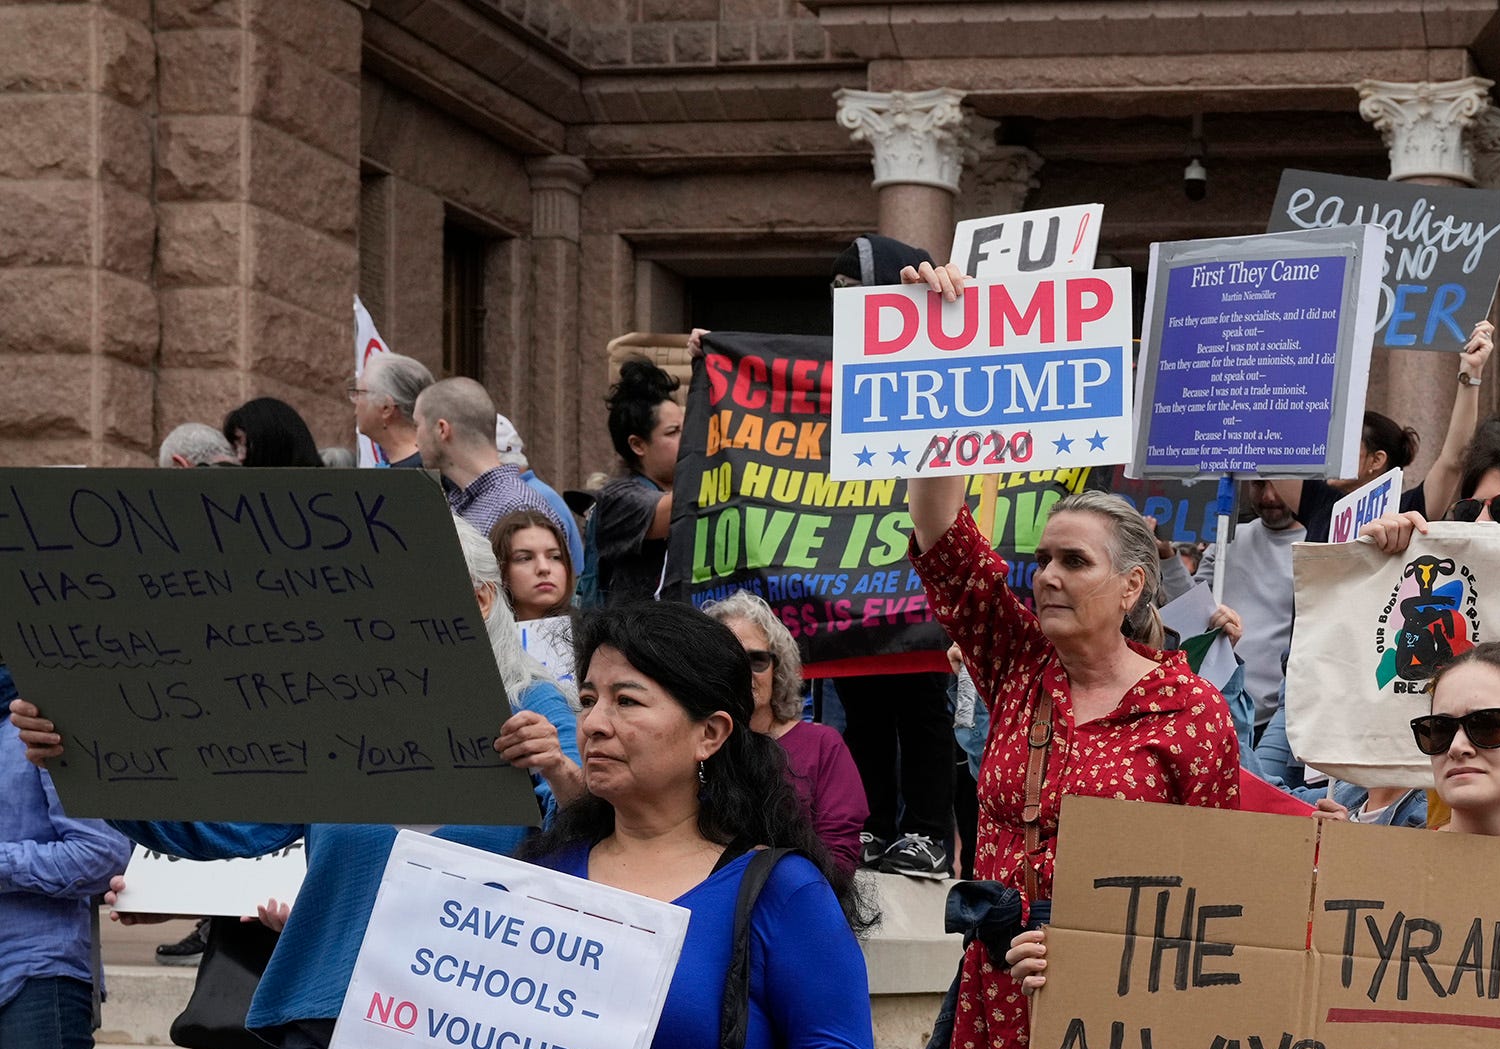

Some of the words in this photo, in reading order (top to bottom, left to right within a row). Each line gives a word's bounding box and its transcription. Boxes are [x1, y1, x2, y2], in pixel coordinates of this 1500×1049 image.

[1191, 265, 1225, 287] First
[1228, 261, 1268, 288] They
[1270, 260, 1319, 281] Came
[1396, 244, 1438, 280] NO
[864, 277, 1114, 356] DUMP
[1168, 316, 1184, 327] First
[1184, 314, 1200, 328] they
[1199, 316, 1218, 325] came
[1218, 312, 1230, 323] for
[1230, 311, 1243, 322] the
[1243, 309, 1281, 322] socialists,
[1282, 308, 1299, 320] and
[1300, 308, 1305, 319] I
[1305, 307, 1320, 319] did
[1321, 309, 1336, 319] not
[1221, 291, 1242, 302] Martin
[1242, 289, 1276, 300] Niemöller
[1196, 343, 1224, 354] Because
[1225, 341, 1229, 352] I
[1230, 343, 1245, 351] was
[1245, 341, 1259, 351] not
[1259, 342, 1265, 351] a
[1266, 338, 1301, 350] socialist.
[1221, 325, 1246, 339] speak
[854, 358, 1111, 423] TRUMP
[706, 411, 828, 460] BLACK
[698, 465, 732, 508] NO
[740, 461, 897, 508] HUMAN
[201, 490, 408, 555] MUSK
[1333, 506, 1352, 543] NO
[692, 507, 831, 584] LOVE
[839, 513, 913, 569] IS
[20, 568, 116, 606] HAS
[140, 570, 232, 599] BEEN
[256, 564, 374, 600] GIVEN
[767, 573, 848, 602] RIGHTS
[851, 571, 901, 596] ARE
[1378, 576, 1406, 624] BODIE
[1460, 565, 1480, 642] DESERVE
[18, 621, 181, 660] ILLEGAL
[206, 619, 325, 650] ACCESS
[344, 617, 396, 642] TO
[410, 616, 477, 646] THE
[1376, 627, 1385, 654] OUR
[118, 682, 211, 723] U.S.
[225, 667, 430, 712] TREASURY
[439, 900, 525, 947] SAVE
[530, 926, 605, 970] OUR
[1094, 875, 1243, 997] THE
[366, 992, 418, 1030] NO
